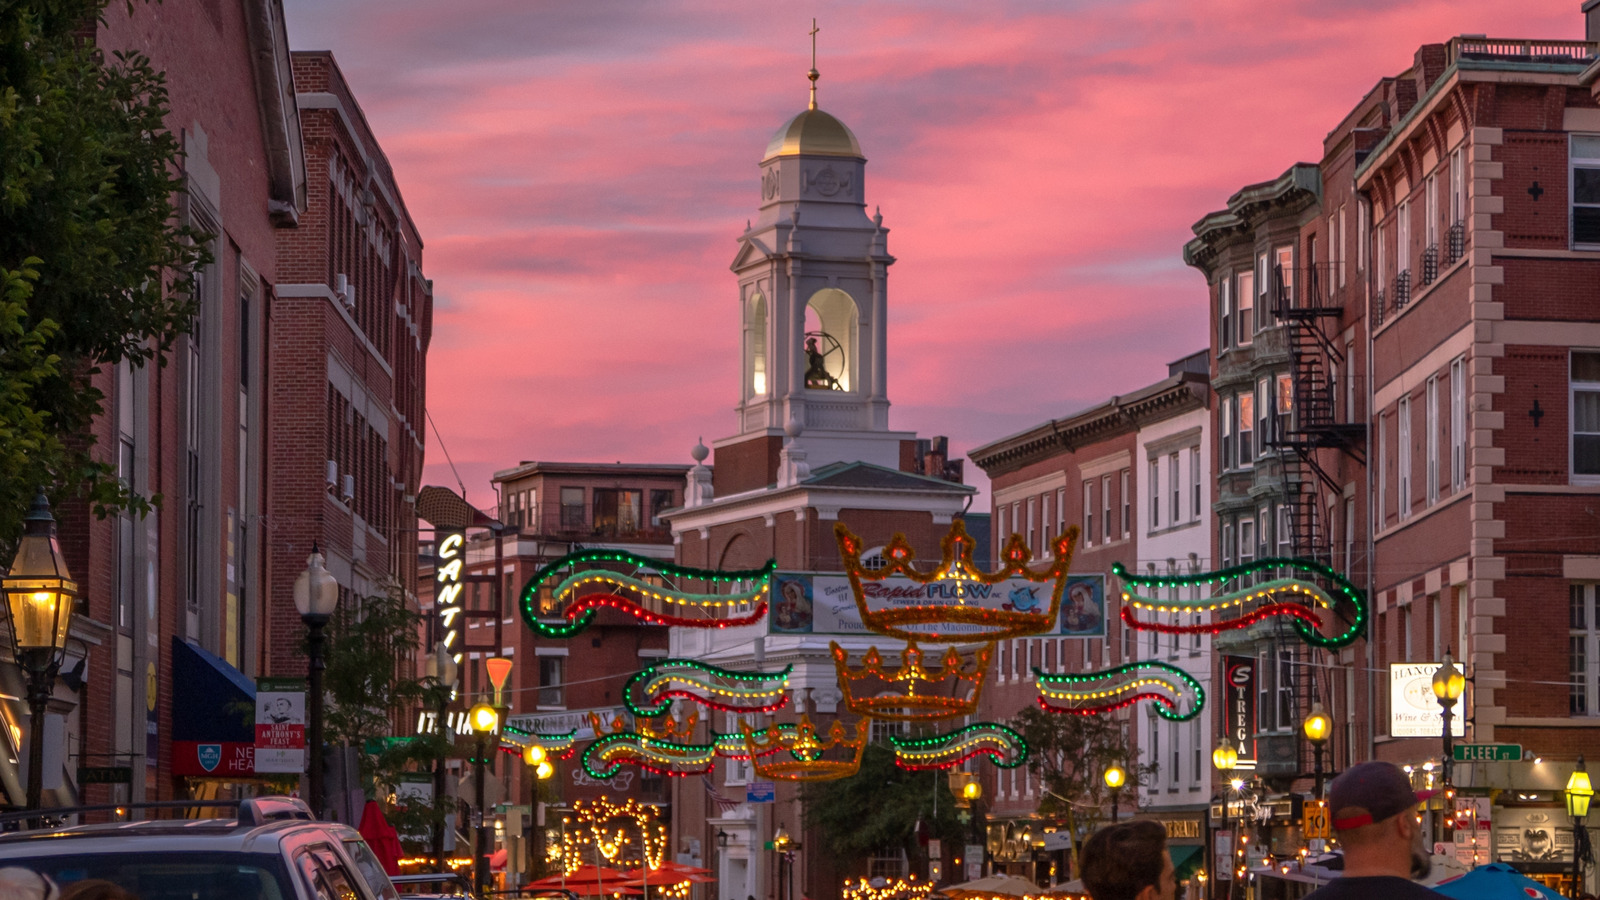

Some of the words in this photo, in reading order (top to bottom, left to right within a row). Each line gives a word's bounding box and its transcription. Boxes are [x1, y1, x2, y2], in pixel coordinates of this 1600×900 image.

[861, 582, 926, 602] Rapid
[927, 583, 992, 599] FLOW
[438, 533, 463, 700] CANTI
[1233, 665, 1252, 755] STREGA
[511, 715, 565, 733] PERRONE
[262, 731, 301, 739] ANTHONY'S
[236, 747, 254, 759] NE
[1463, 746, 1499, 760] FLEET
[229, 759, 254, 771] HEA
[86, 769, 123, 781] ATM
